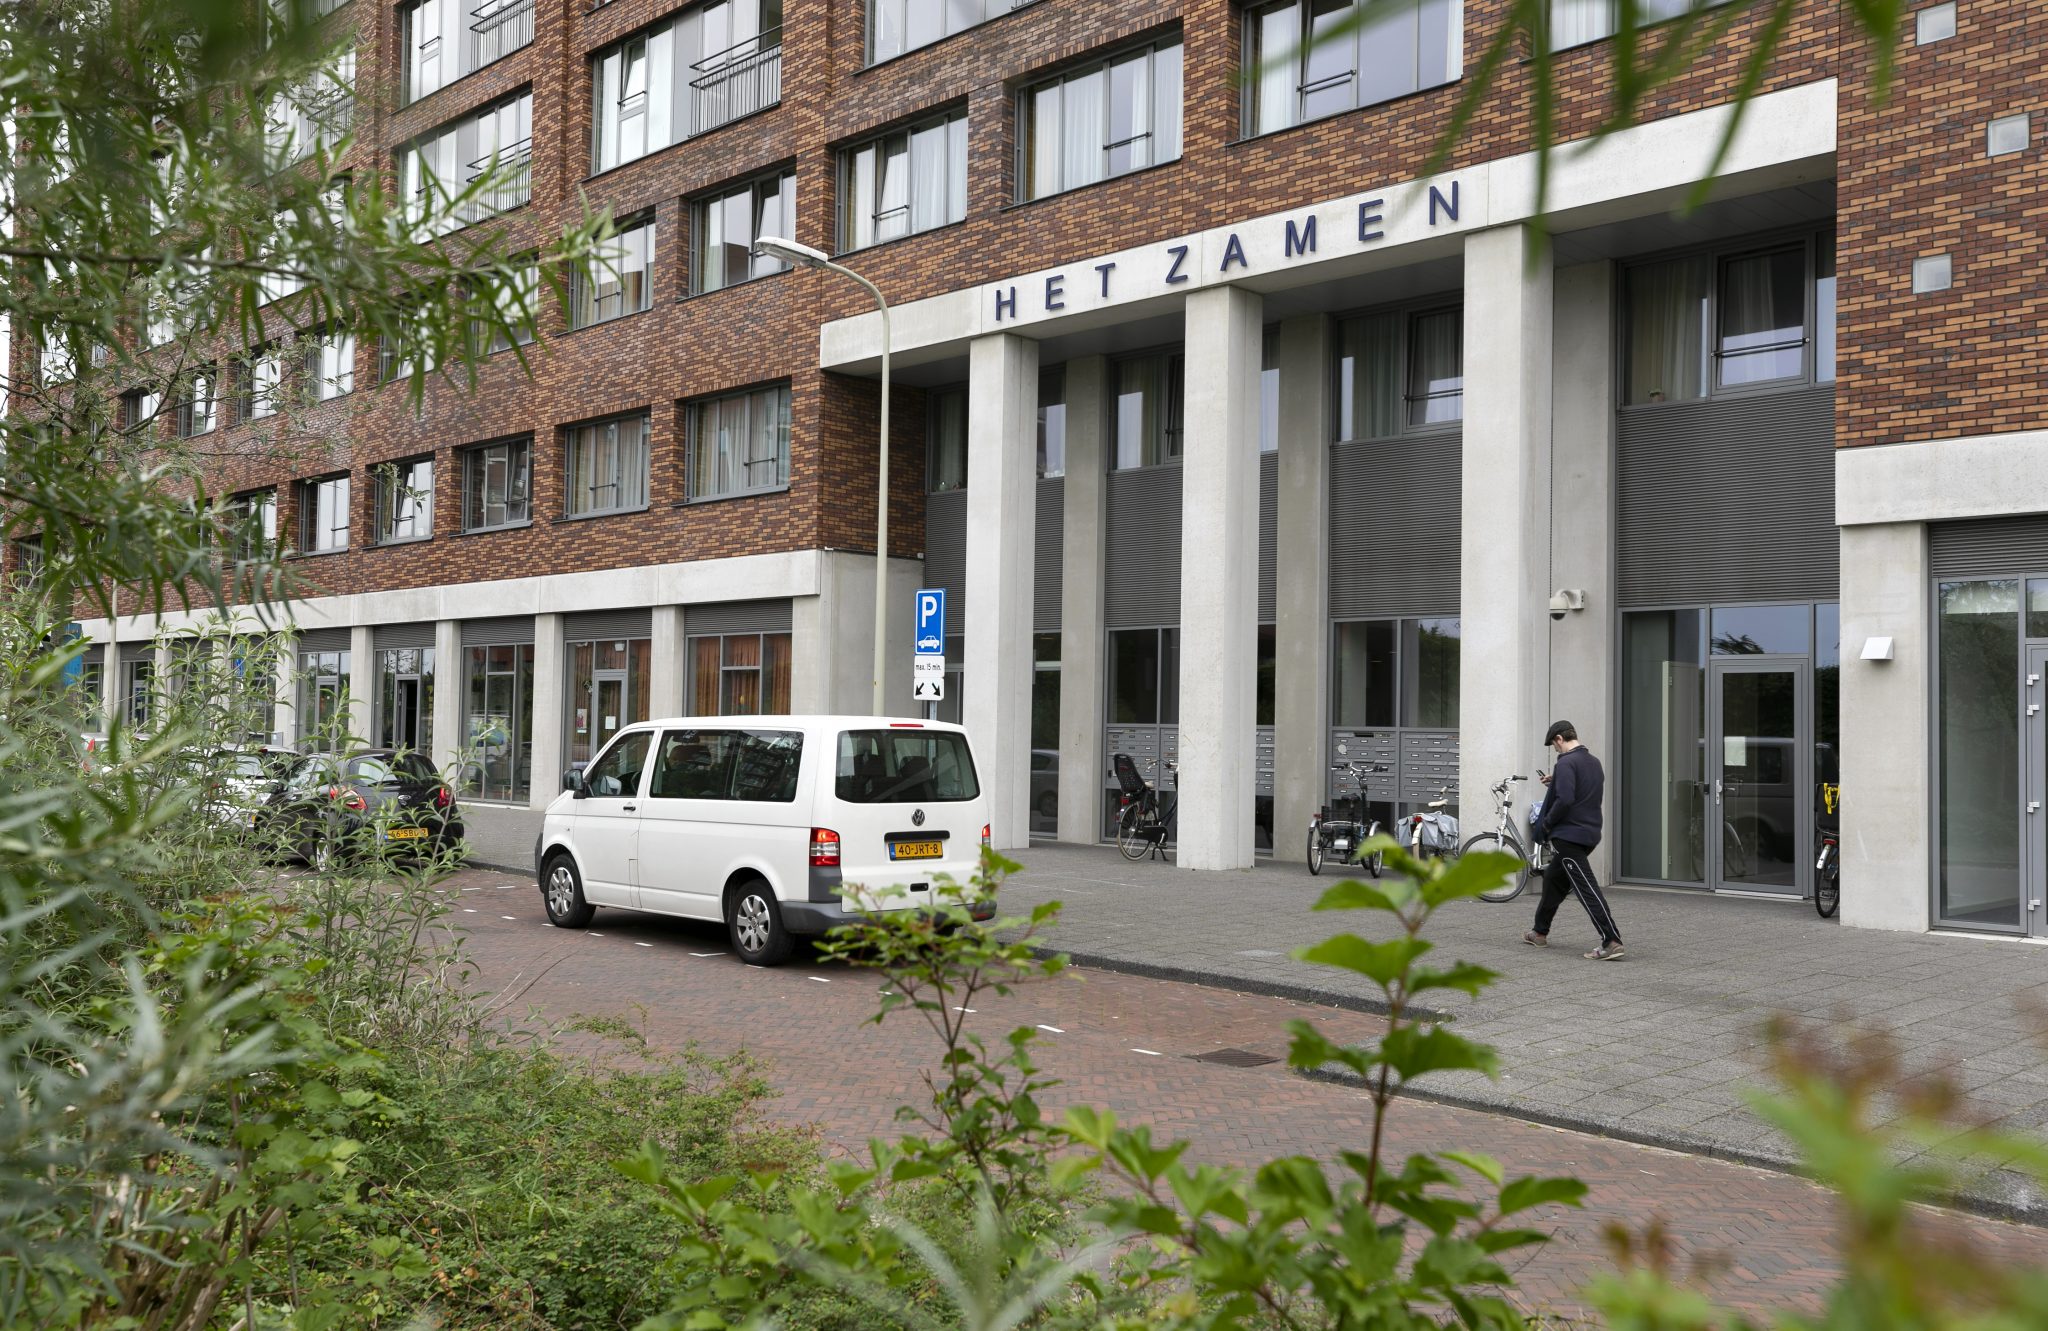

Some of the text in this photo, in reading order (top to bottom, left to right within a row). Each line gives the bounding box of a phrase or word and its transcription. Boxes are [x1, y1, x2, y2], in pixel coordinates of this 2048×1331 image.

[995, 180, 1459, 321] HET ZAMEN
[921, 596, 938, 628] P
[899, 844, 938, 855] 40-JRT-8
